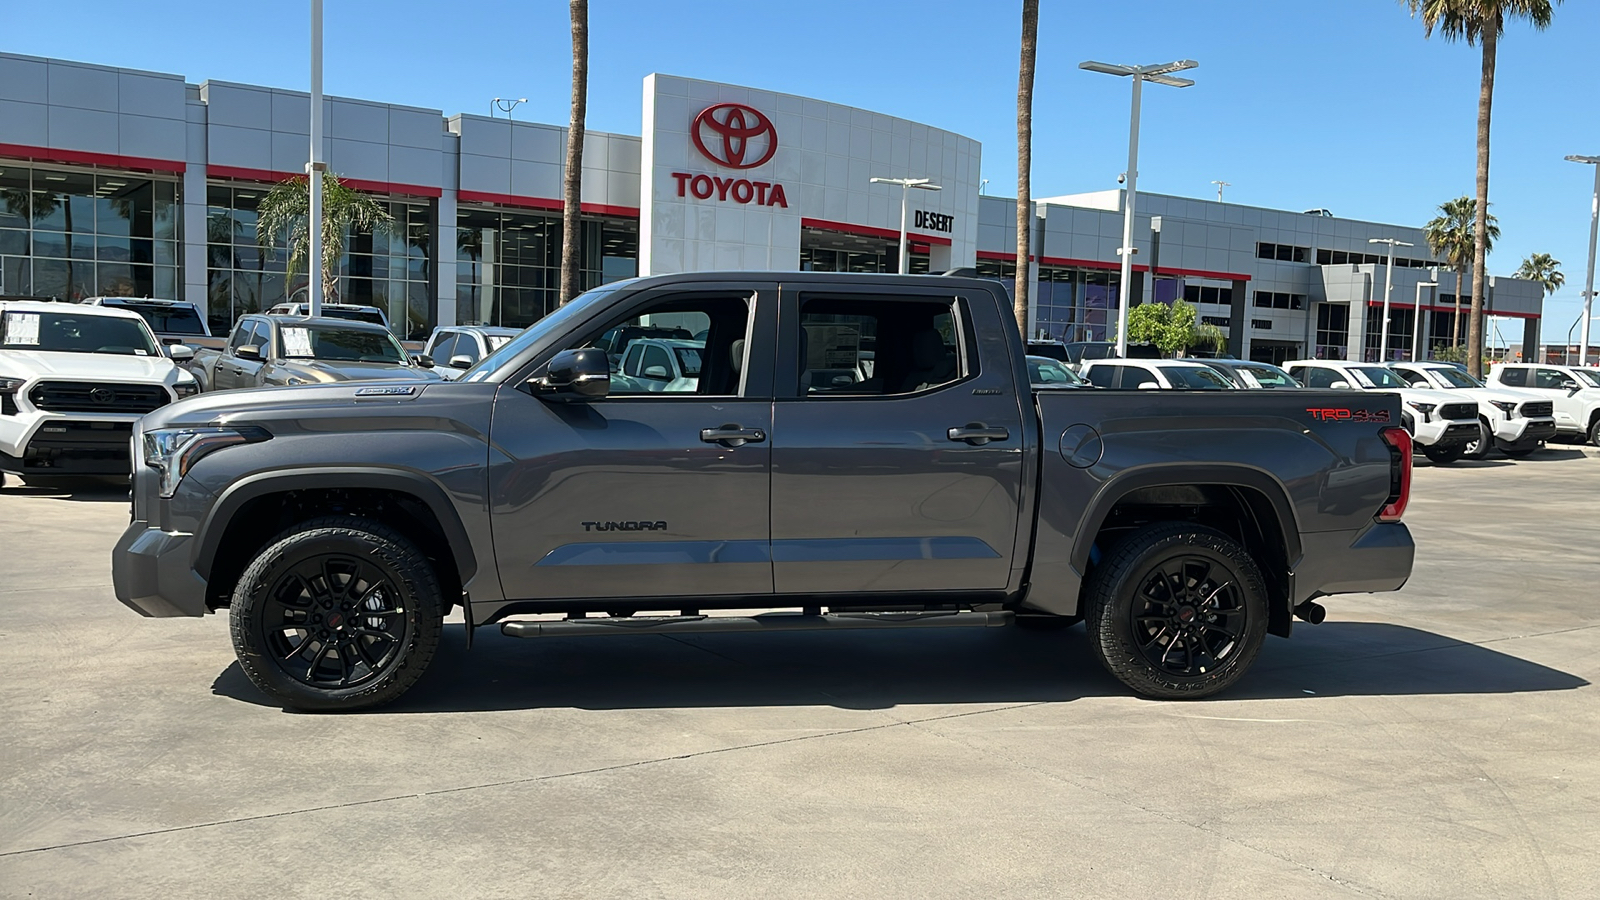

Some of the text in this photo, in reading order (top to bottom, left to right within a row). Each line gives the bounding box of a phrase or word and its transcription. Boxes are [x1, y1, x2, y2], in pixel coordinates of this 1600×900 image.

[672, 172, 788, 208] TOYOTA
[914, 210, 954, 233] DESERT
[1306, 408, 1351, 421] TRD
[581, 521, 667, 532] TUNDRA
